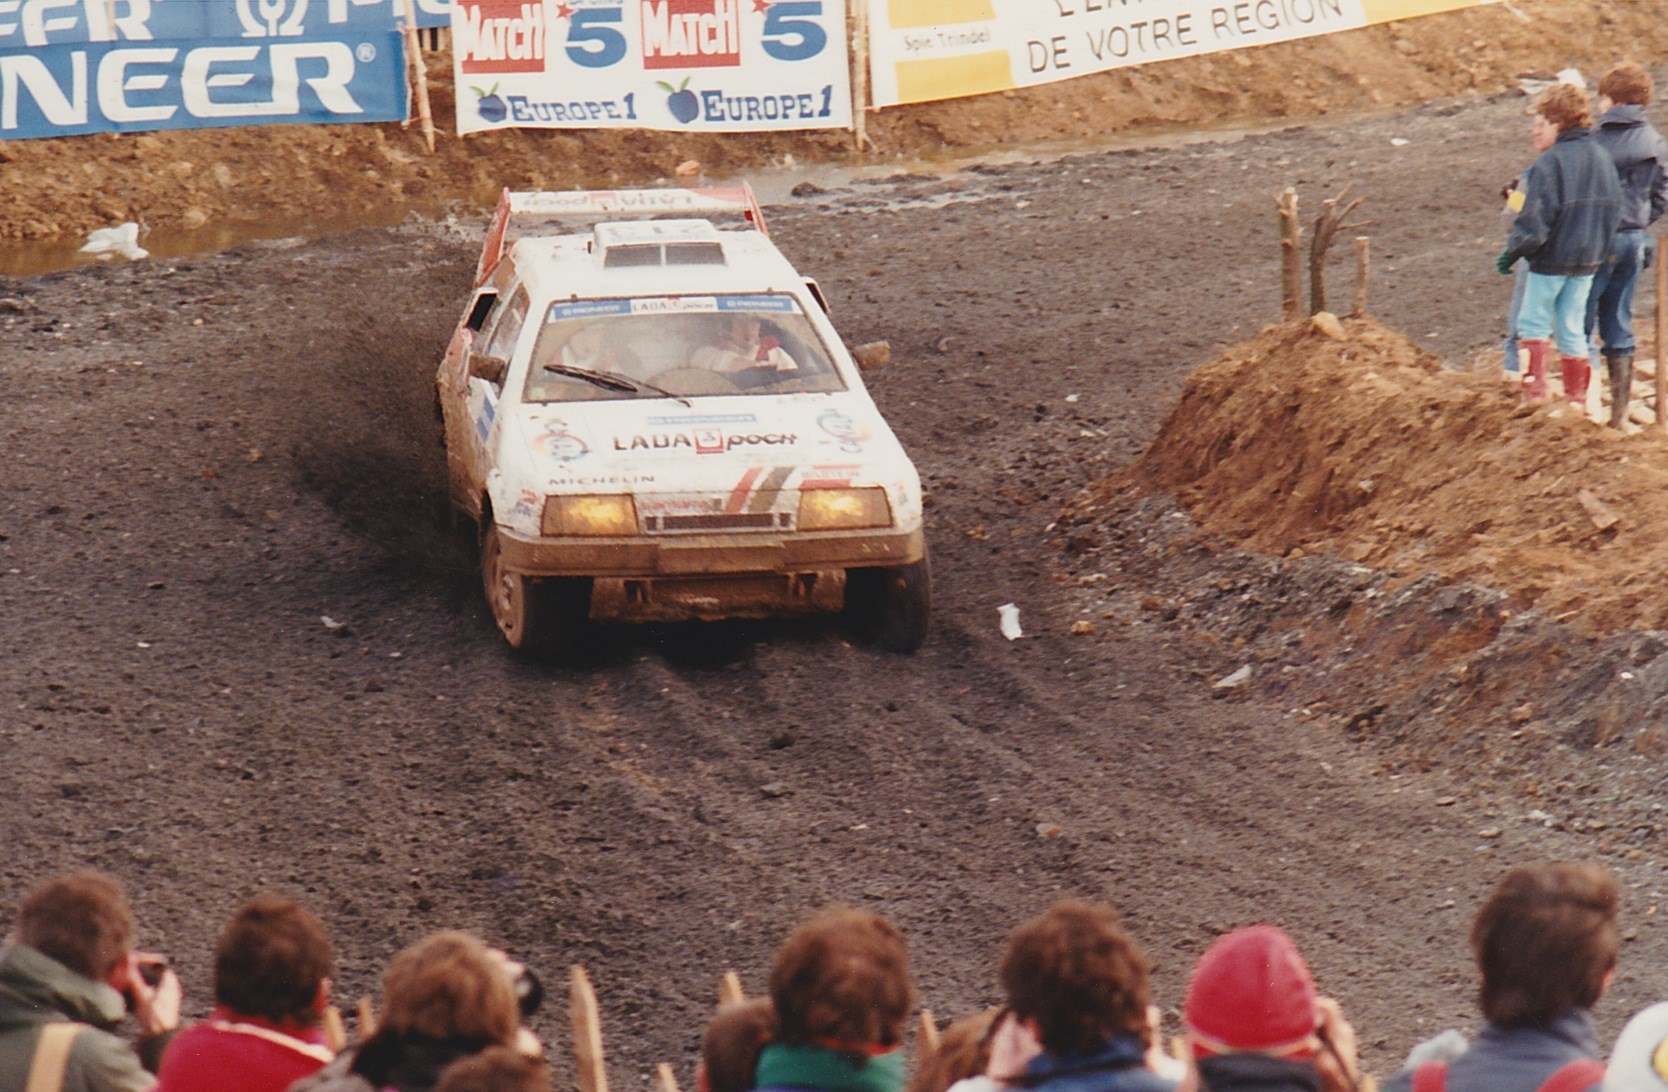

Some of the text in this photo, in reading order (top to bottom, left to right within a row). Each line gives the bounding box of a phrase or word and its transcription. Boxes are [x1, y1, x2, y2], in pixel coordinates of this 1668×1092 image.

[456, 3, 543, 61] MATCH
[565, 7, 628, 69] 5
[641, 0, 738, 57] MATCH
[761, 0, 828, 62] 5
[1027, 36, 1071, 73] DE
[1086, 13, 1197, 61] VOTRE
[549, 475, 656, 485] MICHELIN
